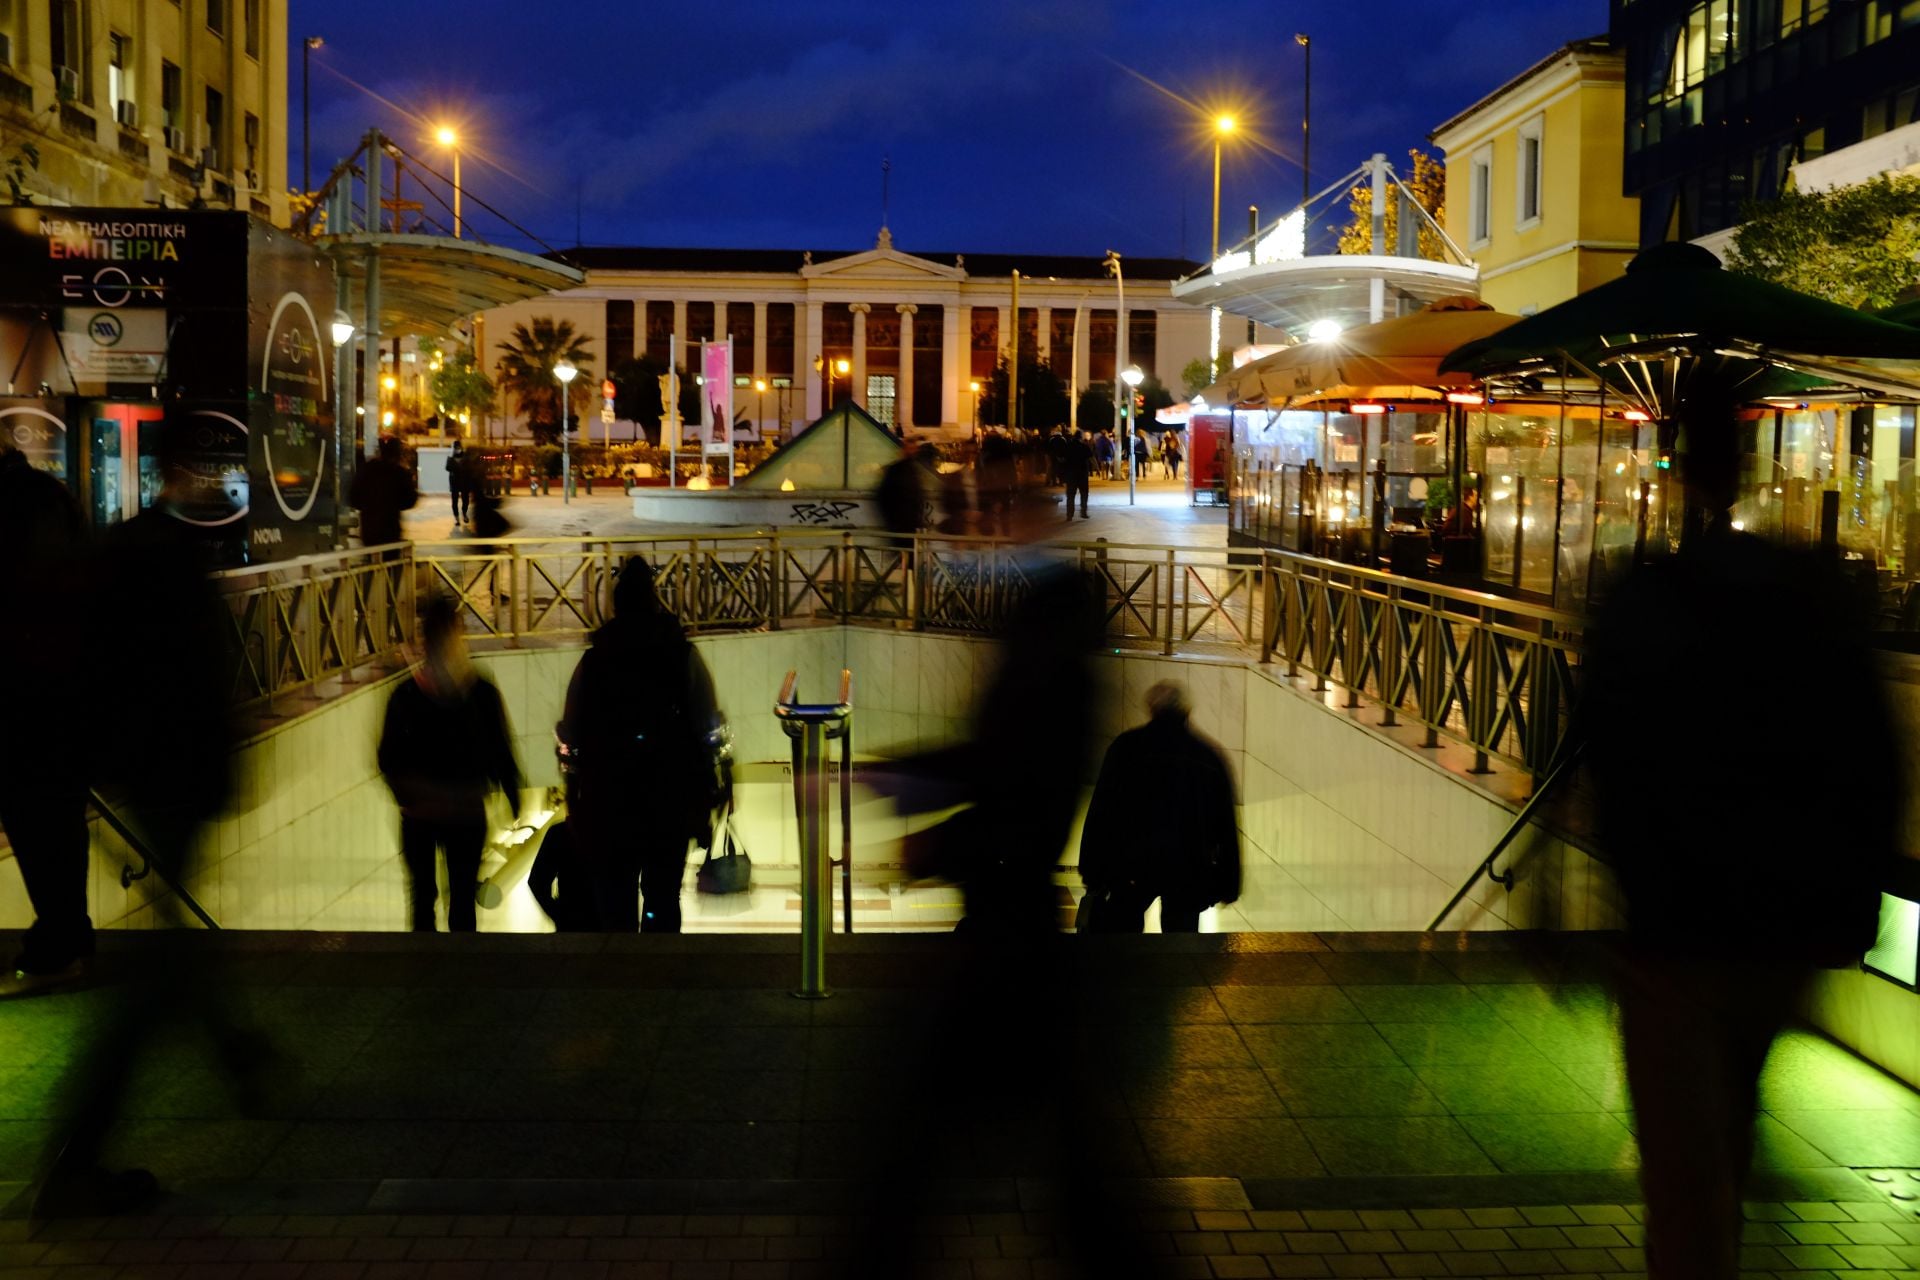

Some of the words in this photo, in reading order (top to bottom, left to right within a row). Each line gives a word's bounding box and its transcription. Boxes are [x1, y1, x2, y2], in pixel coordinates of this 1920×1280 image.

[39, 220, 73, 236] ΝΕΑ
[75, 221, 186, 239] ΤΗΛΕΟΠΤΙΚΗ
[49, 237, 179, 262] ΕΜΠΕΙΡΙΑ
[62, 266, 164, 308] EON
